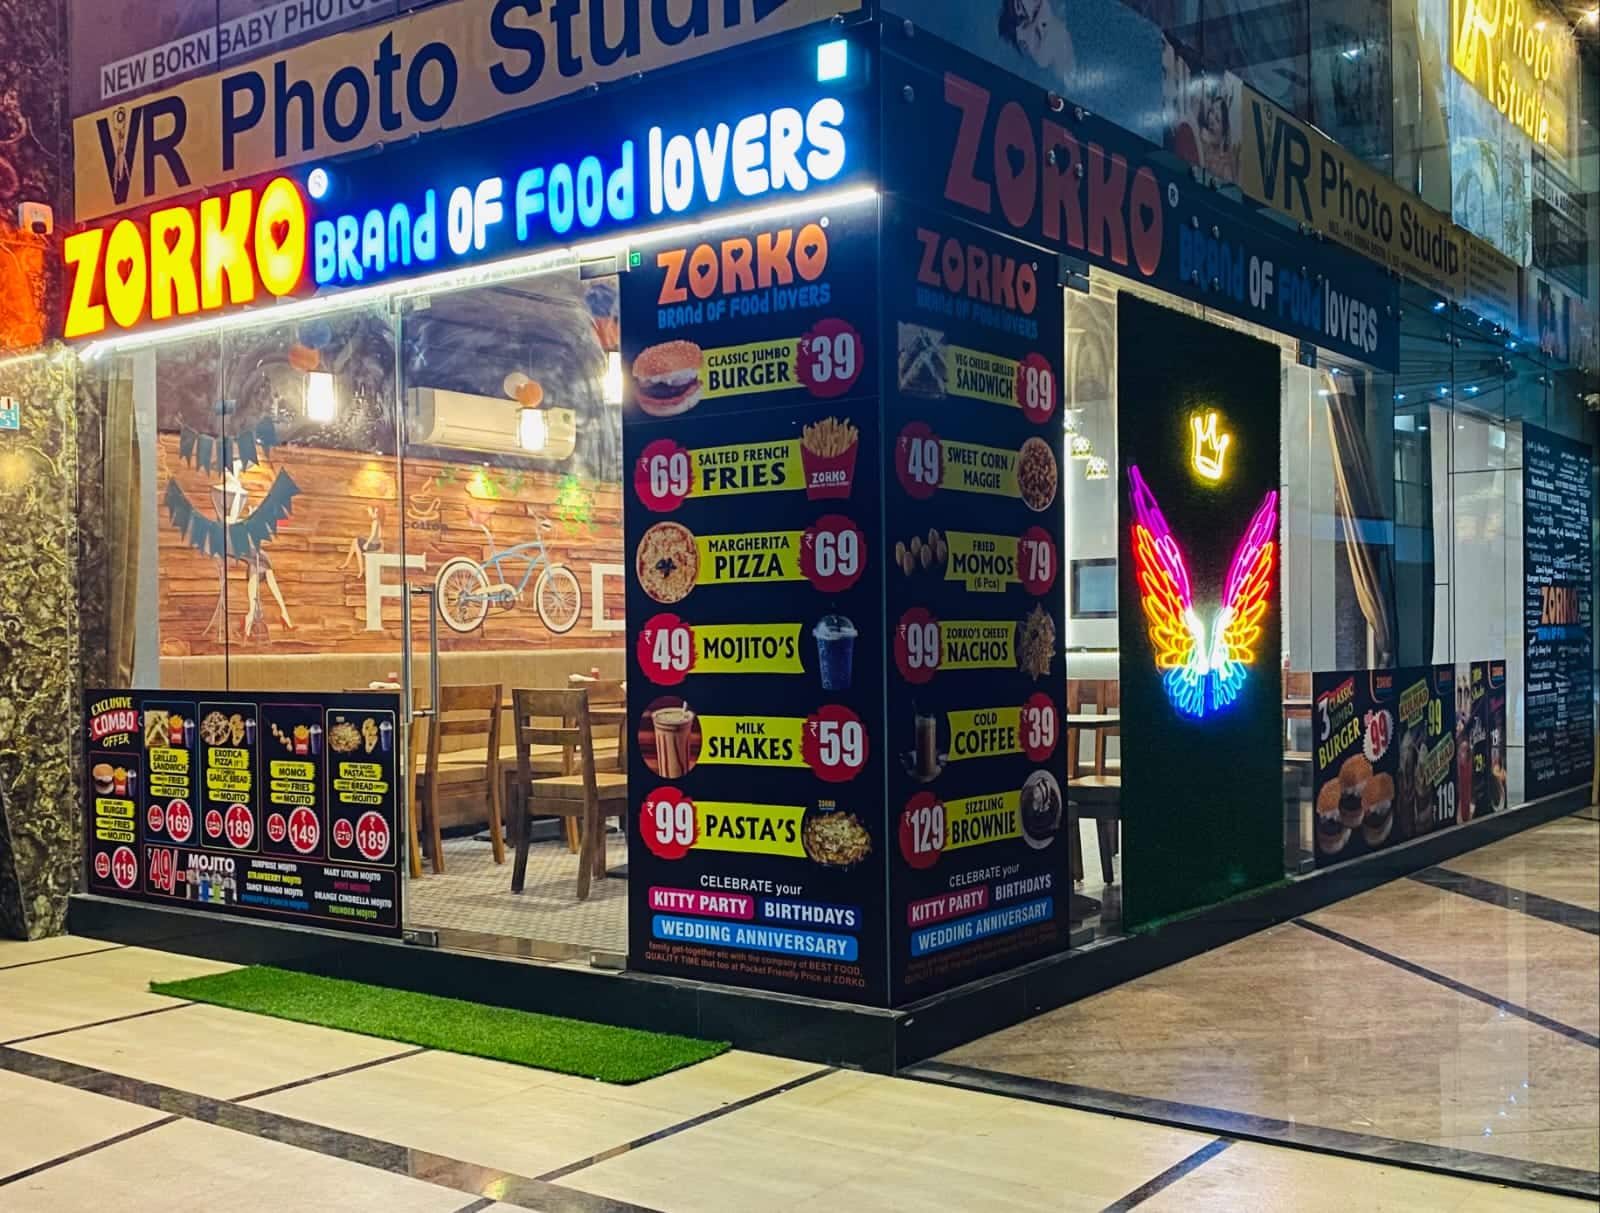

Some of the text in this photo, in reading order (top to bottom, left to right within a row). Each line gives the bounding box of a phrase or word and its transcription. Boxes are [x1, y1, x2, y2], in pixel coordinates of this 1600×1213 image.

[103, 57, 148, 96] NEW
[152, 38, 211, 79] BORN
[219, 14, 279, 55] BABY
[97, 96, 192, 206] VR
[221, 31, 458, 172] Photo
[943, 71, 1163, 276] ZORKO
[1252, 100, 1313, 222] VR
[1321, 149, 1393, 236] Photo
[447, 177, 502, 254] OF
[64, 176, 306, 338] ZORKO
[657, 224, 828, 305] ZORKO
[917, 227, 1037, 315] ZORKO
[1249, 256, 1273, 310] OF
[706, 301, 726, 322] OF
[708, 345, 790, 368] CLASSIC JUMBO
[708, 363, 790, 391] BURGER
[957, 370, 1013, 400] SANDWICH
[698, 446, 789, 467] SALTED FRENCH
[947, 446, 1008, 469] SWEET CORN
[703, 463, 786, 491] FRIES
[811, 470, 847, 484] ZORKO
[964, 470, 1001, 489] MAGGIE
[708, 535, 790, 552] MARGHERITA
[714, 553, 784, 579] PIZZA
[952, 553, 1014, 575] MOMOS
[947, 641, 1008, 662] NACHOS
[91, 697, 132, 716] EXCLUSIVE
[1318, 697, 1331, 740] 3
[94, 711, 135, 734] COMBO
[736, 722, 766, 735] MILK
[974, 711, 998, 727] COLD
[103, 733, 130, 747] OFFER
[708, 737, 793, 760] SHAKES
[954, 726, 1015, 756] COFFEE
[1318, 717, 1361, 769] BURGER
[279, 767, 307, 777] MOMOS
[220, 793, 246, 802] MOJITO
[351, 782, 374, 791] BREAD
[965, 797, 1004, 815] SIZZLING
[114, 820, 130, 831] FRIES
[706, 814, 796, 843] PASTA'S
[951, 811, 1016, 844] BROWNIE
[188, 853, 235, 873] MOJITO
[700, 875, 803, 896] CELEBRATE your
[949, 863, 1020, 888] CELEBRATE your
[995, 873, 1053, 901] BIRTHDAYS
[654, 891, 747, 914] KITTY PARTY
[764, 902, 856, 926] BIRTHDAYS
[912, 889, 984, 923] KITTY PARTY
[918, 901, 1048, 950] WEDDING ANNIVERSARY
[661, 920, 848, 956] WEDDING ANNIVERSARY
